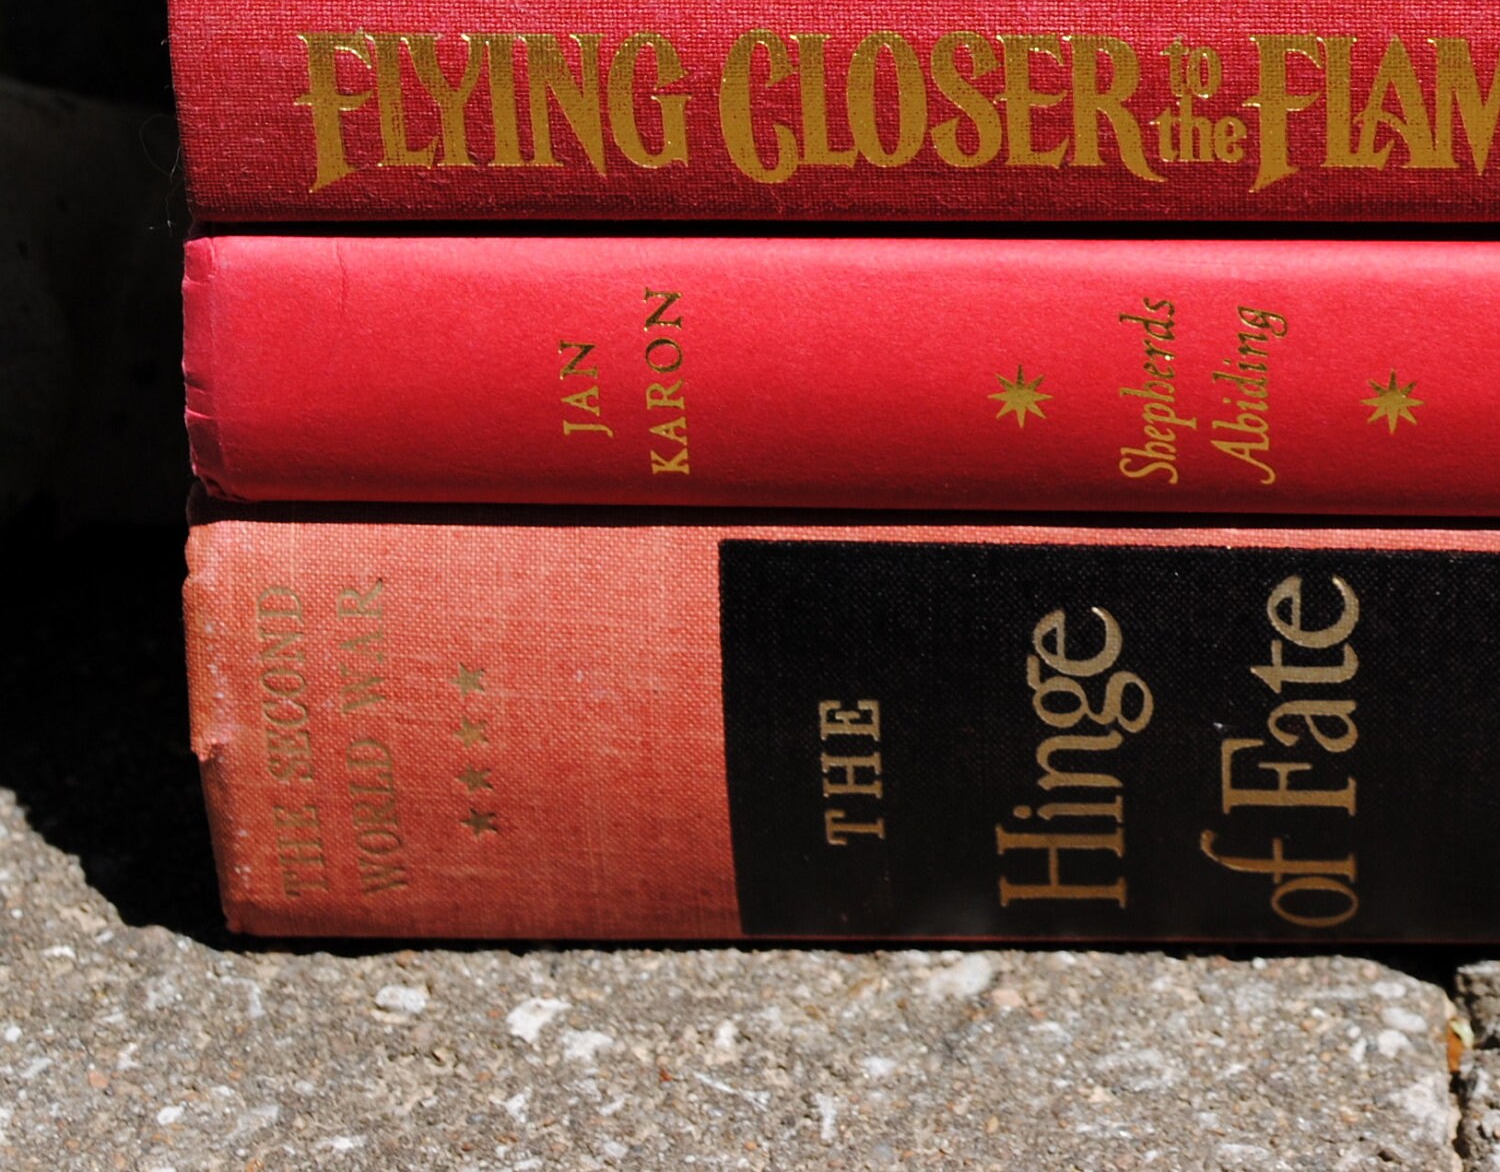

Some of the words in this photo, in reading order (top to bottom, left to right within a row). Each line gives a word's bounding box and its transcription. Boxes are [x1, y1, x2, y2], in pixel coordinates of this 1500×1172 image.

[294, 27, 692, 193] FLYING
[718, 27, 1166, 184] CLOSER
[1149, 93, 1244, 163] the
[1159, 34, 1223, 99] to
[559, 338, 614, 438] JAN
[643, 286, 690, 476] KARON
[1118, 295, 1197, 485] Shepherds
[1211, 305, 1289, 486] Abiding
[256, 586, 314, 782] SECOND
[337, 577, 386, 714] WAR
[1221, 573, 1360, 817] Fate
[346, 738, 408, 896] WORLD
[818, 699, 886, 846] THE
[996, 605, 1154, 910] Hinge
[273, 804, 330, 900] THE
[1201, 829, 1360, 929] of
